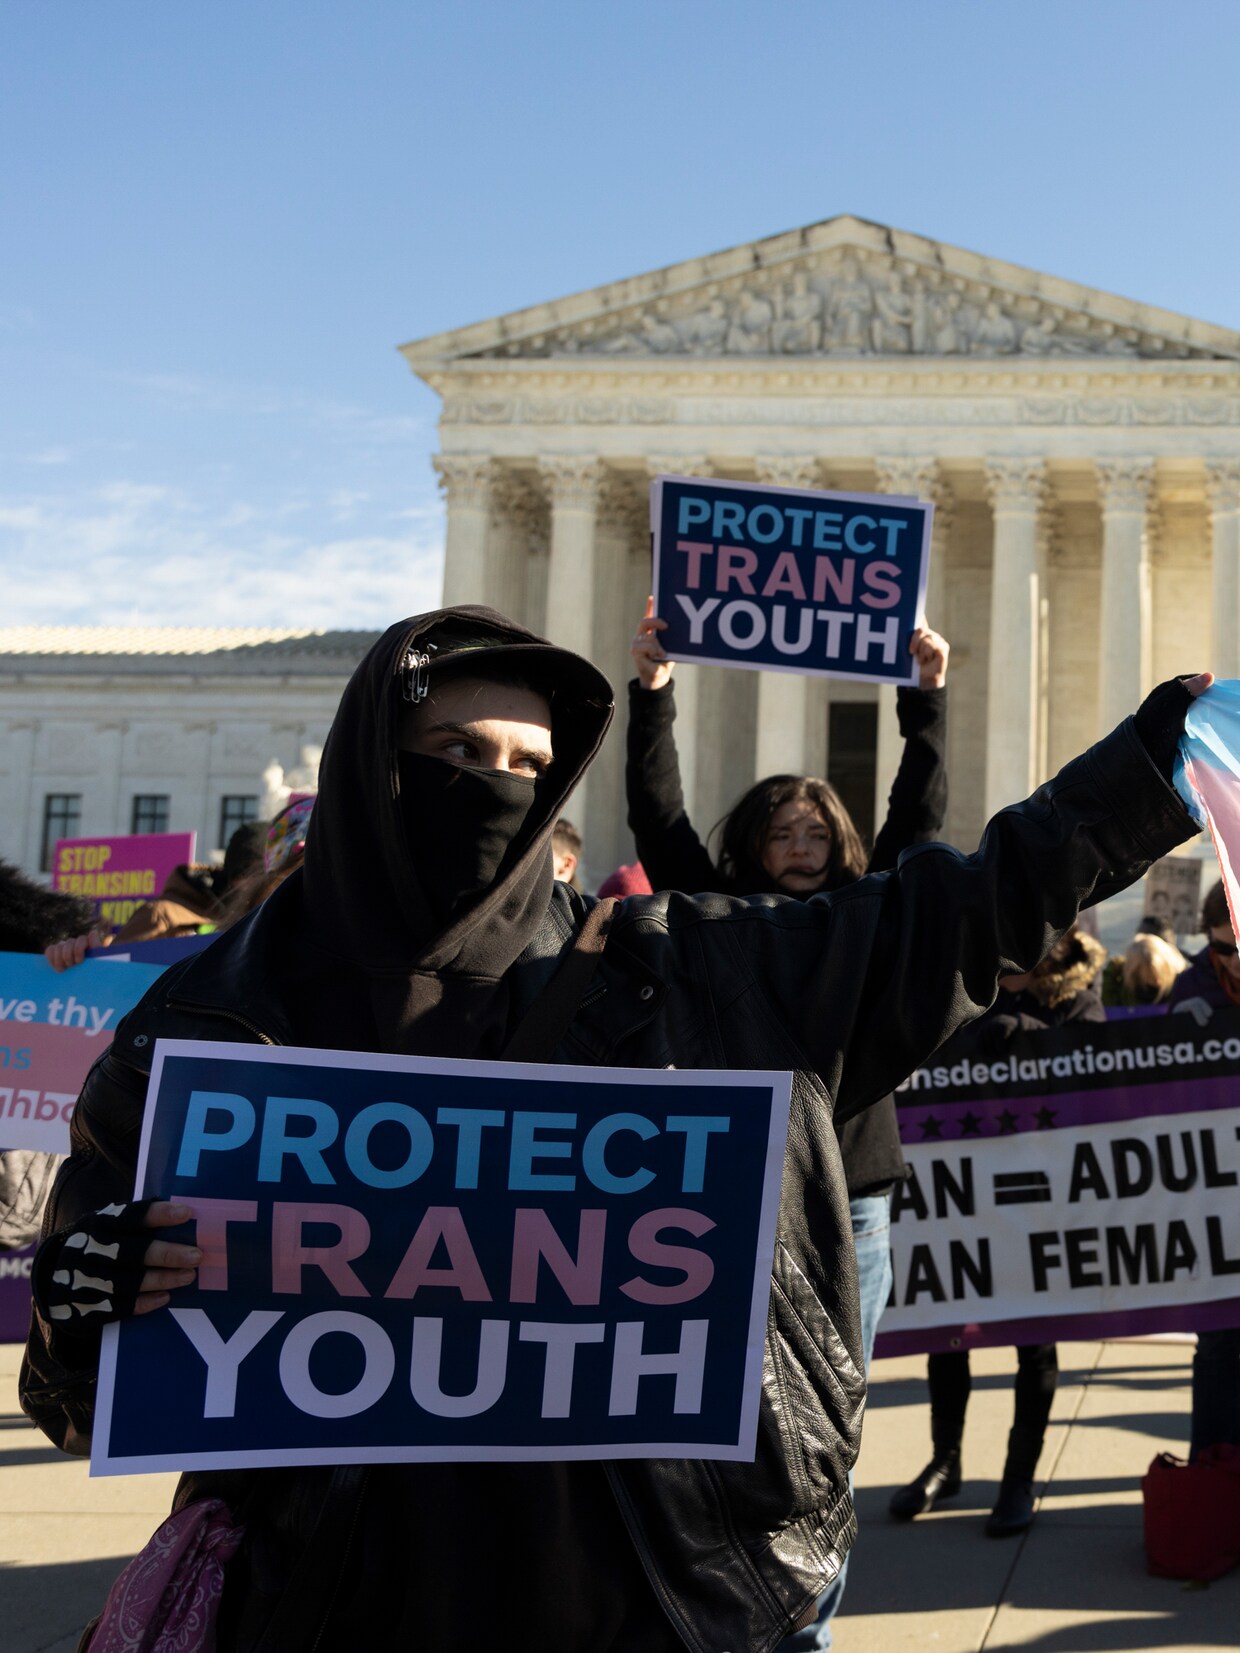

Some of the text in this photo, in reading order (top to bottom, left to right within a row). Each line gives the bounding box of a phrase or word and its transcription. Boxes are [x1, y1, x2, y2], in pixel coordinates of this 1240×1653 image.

[677, 497, 907, 556] PROTECT
[677, 541, 902, 609] TRANS
[675, 594, 899, 664] YOUTH
[59, 870, 155, 896] TRANSING
[60, 845, 111, 872] STOP
[102, 900, 146, 925] KID
[48, 996, 114, 1037] thy
[176, 1091, 730, 1193] PROTECT
[171, 1196, 718, 1305] TRANS
[886, 1237, 993, 1307] AN
[168, 1307, 710, 1419] YOUTH
